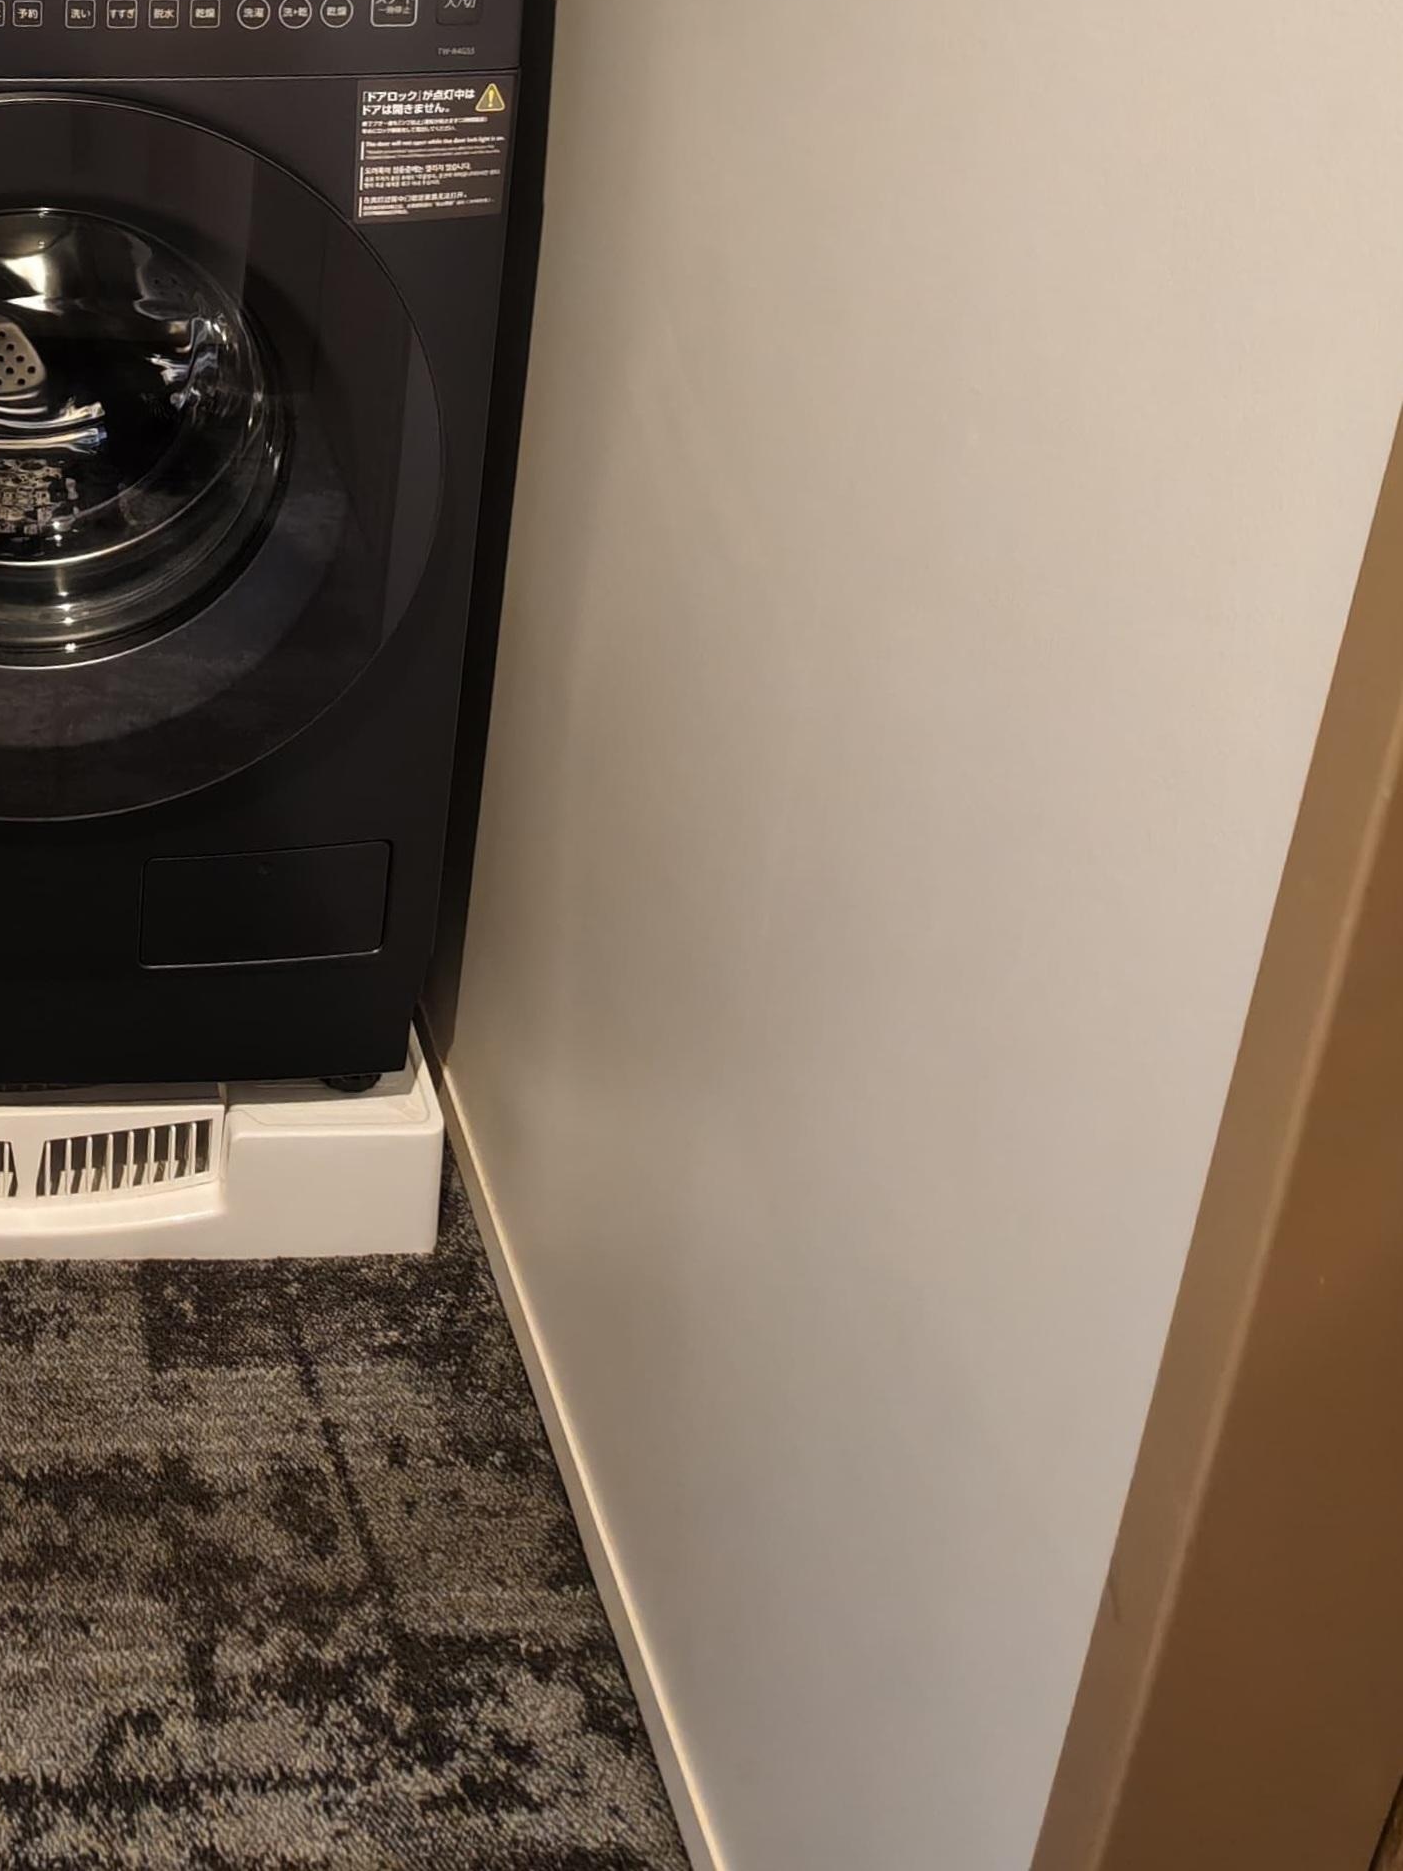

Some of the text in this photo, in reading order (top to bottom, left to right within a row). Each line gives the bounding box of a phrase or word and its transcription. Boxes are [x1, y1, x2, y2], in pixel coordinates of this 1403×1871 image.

[16, 8, 39, 20] 予約
[70, 8, 91, 20] 洗い
[109, 8, 136, 20] すすぎ
[153, 8, 175, 20] 脱水
[362, 102, 451, 116] ドアは開きません。
